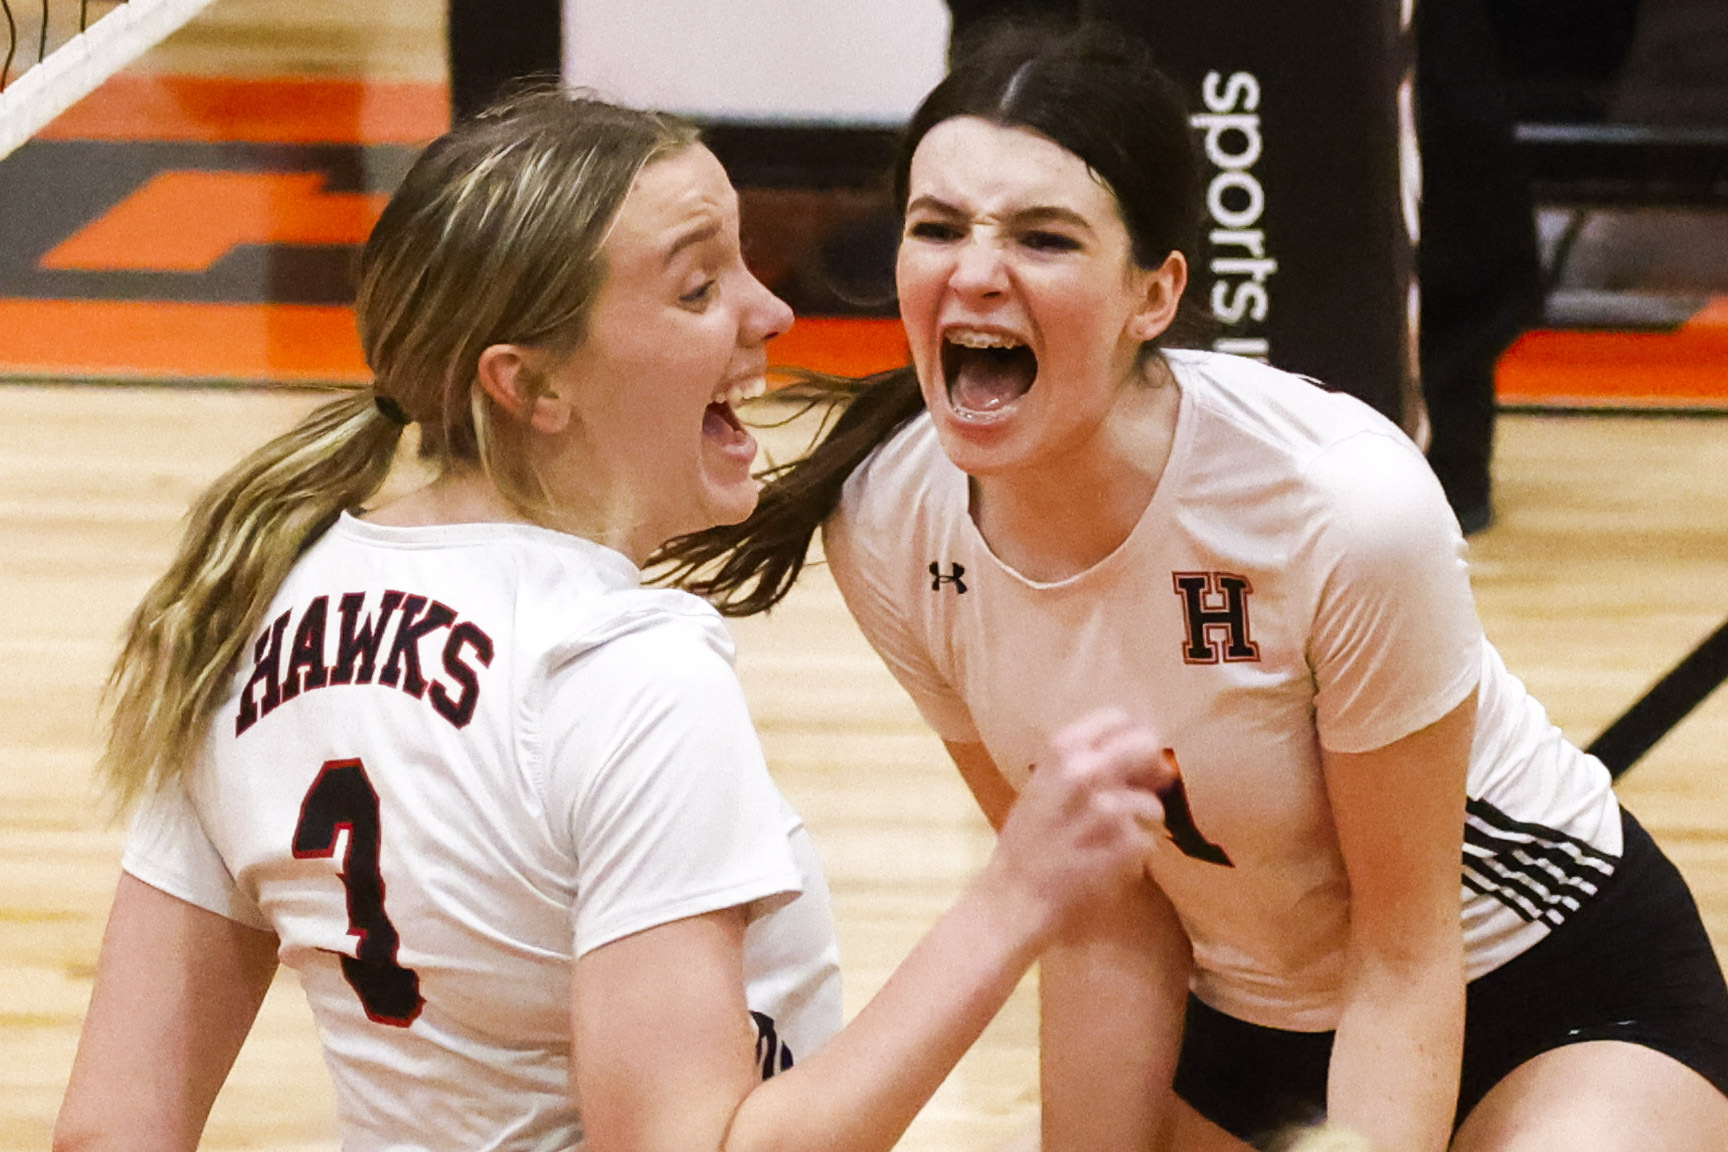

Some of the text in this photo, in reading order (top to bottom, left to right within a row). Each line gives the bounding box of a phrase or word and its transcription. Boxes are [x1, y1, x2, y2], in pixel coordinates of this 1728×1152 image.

[1190, 71, 1277, 325] sports
[235, 589, 494, 738] HAWKS
[1172, 571, 1261, 665] H
